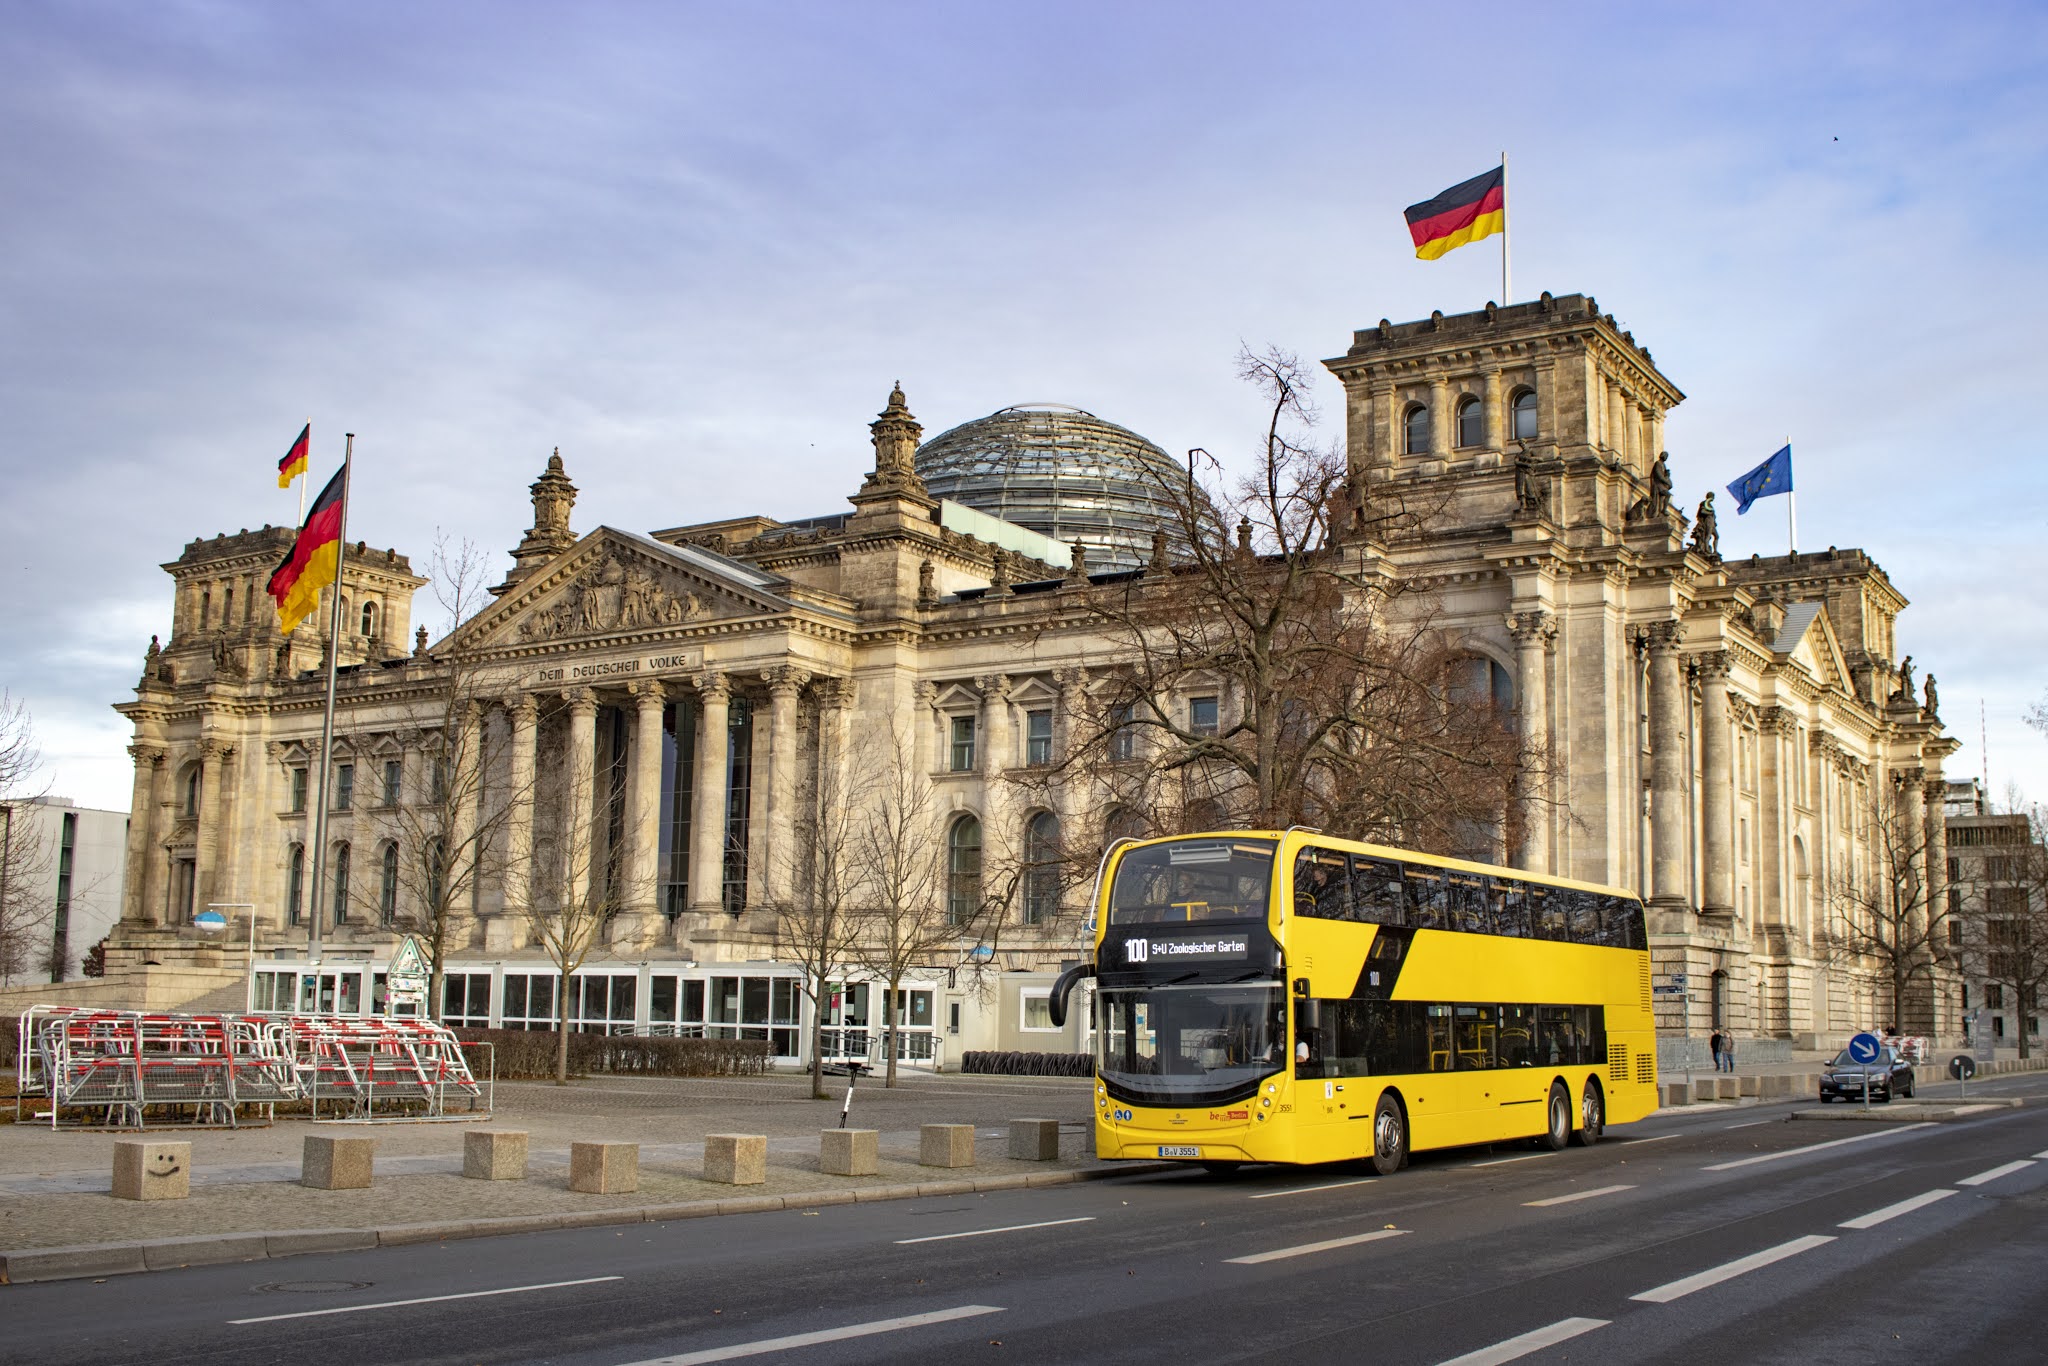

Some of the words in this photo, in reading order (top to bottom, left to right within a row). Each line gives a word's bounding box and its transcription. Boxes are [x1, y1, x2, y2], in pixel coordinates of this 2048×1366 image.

[539, 668, 564, 682] DEM
[573, 660, 640, 678] DEUTSCHEN
[650, 655, 686, 669] VOLKE
[1125, 938, 1148, 962] 100
[1152, 943, 1167, 954] S+U
[1168, 942, 1216, 954] Zoologischer
[1218, 941, 1245, 952] Garten
[1370, 971, 1380, 986] 100
[1209, 1111, 1220, 1121] be
[1179, 1147, 1197, 1156] 3551
